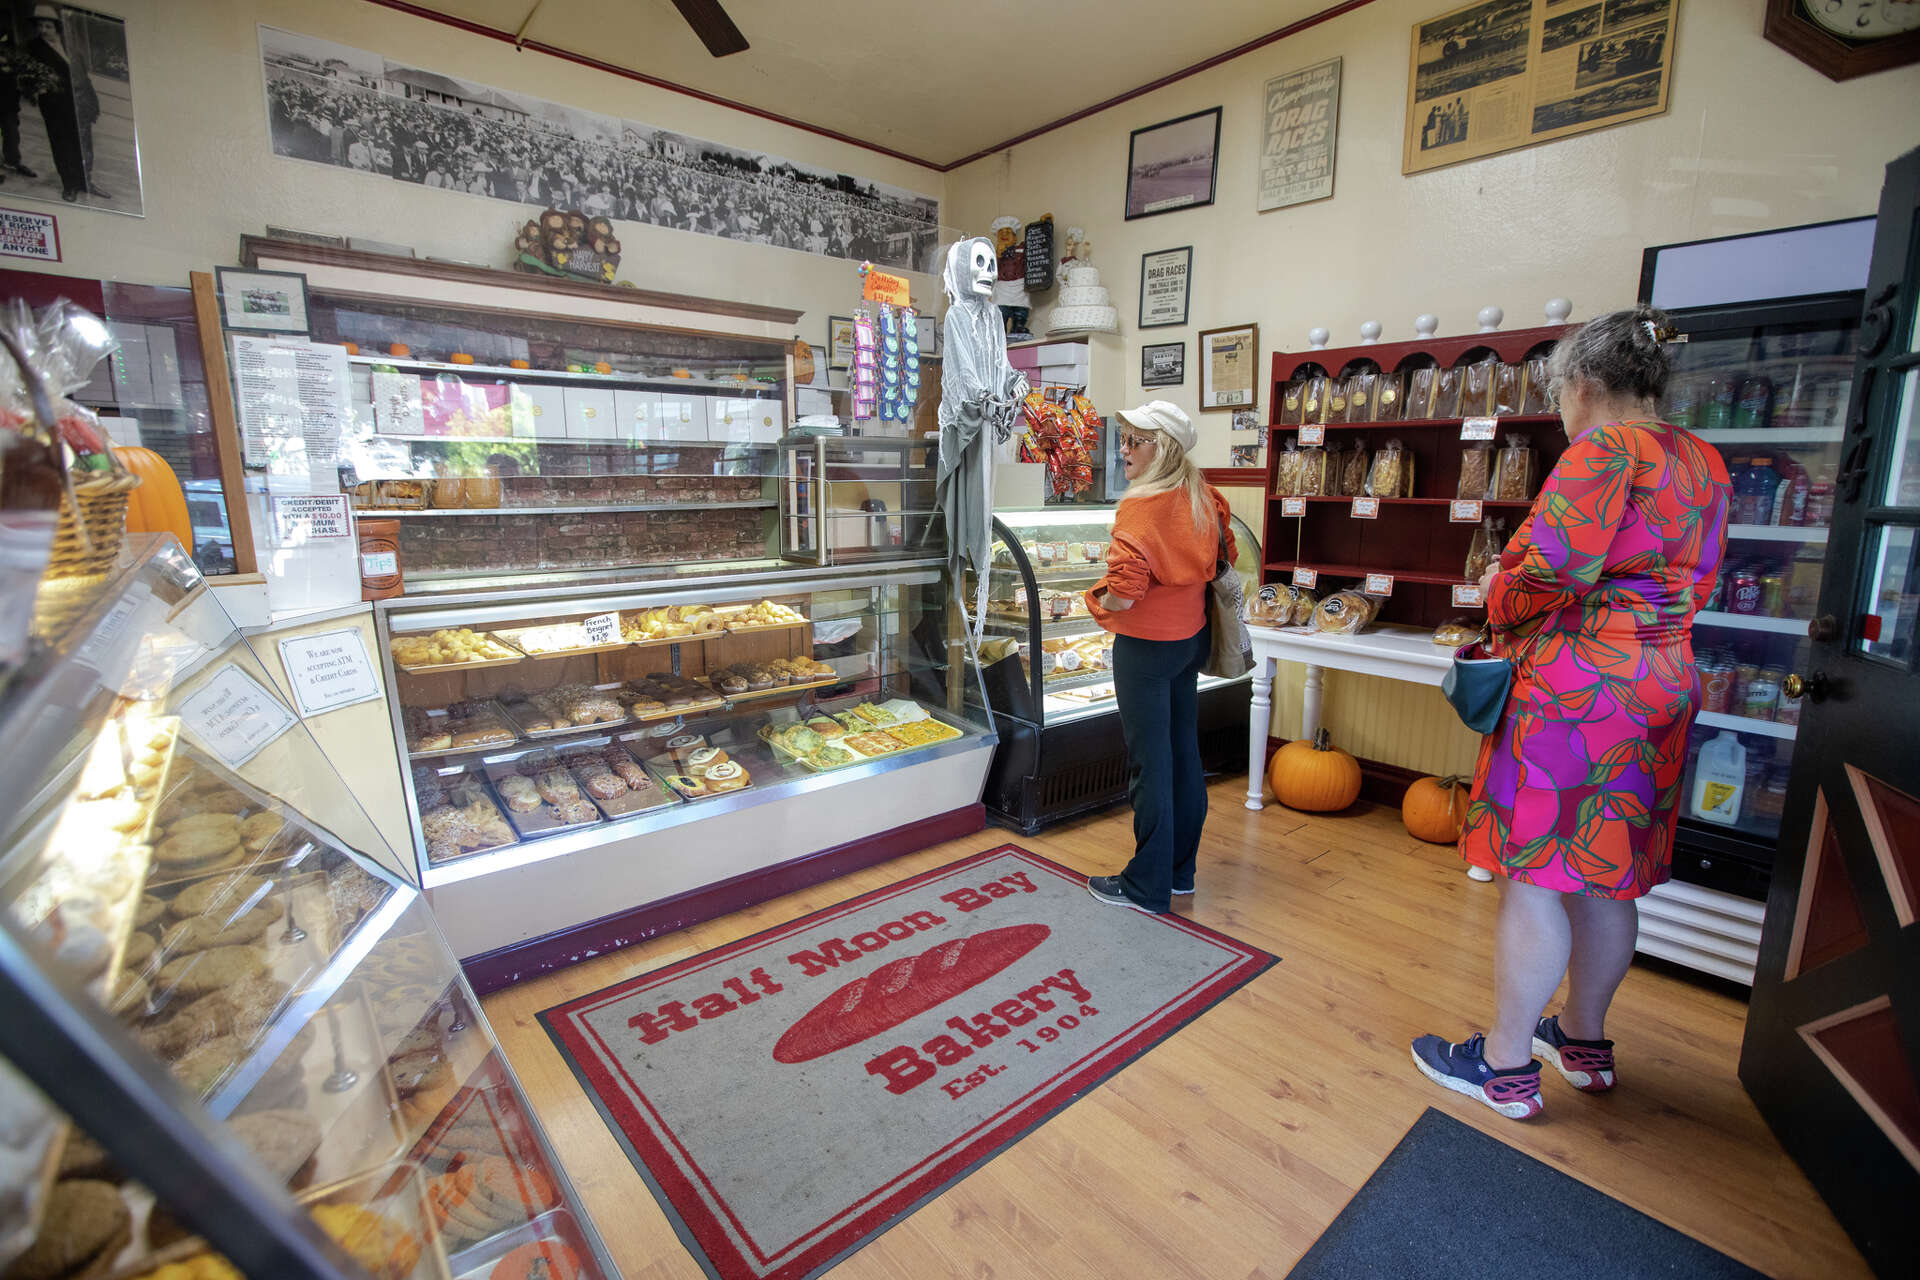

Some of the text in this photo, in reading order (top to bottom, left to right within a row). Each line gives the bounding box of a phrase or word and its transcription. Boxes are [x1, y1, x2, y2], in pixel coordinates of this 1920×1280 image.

[1270, 99, 1329, 133] DRAG
[1267, 120, 1329, 156] RACES
[9, 221, 42, 232] RIGHT
[3, 243, 49, 255] ANYONE
[572, 249, 595, 261] HAPPY
[569, 261, 601, 273] HARVEST
[1148, 263, 1186, 279] DRAG RACES
[365, 557, 393, 571] Tips
[585, 616, 611, 627] French
[587, 622, 613, 634] Beignet
[337, 655, 353, 665] ATM
[628, 871, 1038, 1045] Half Moon Bay
[864, 969, 1092, 1095] Bakery
[940, 1004, 1099, 1100] Est. 1904
